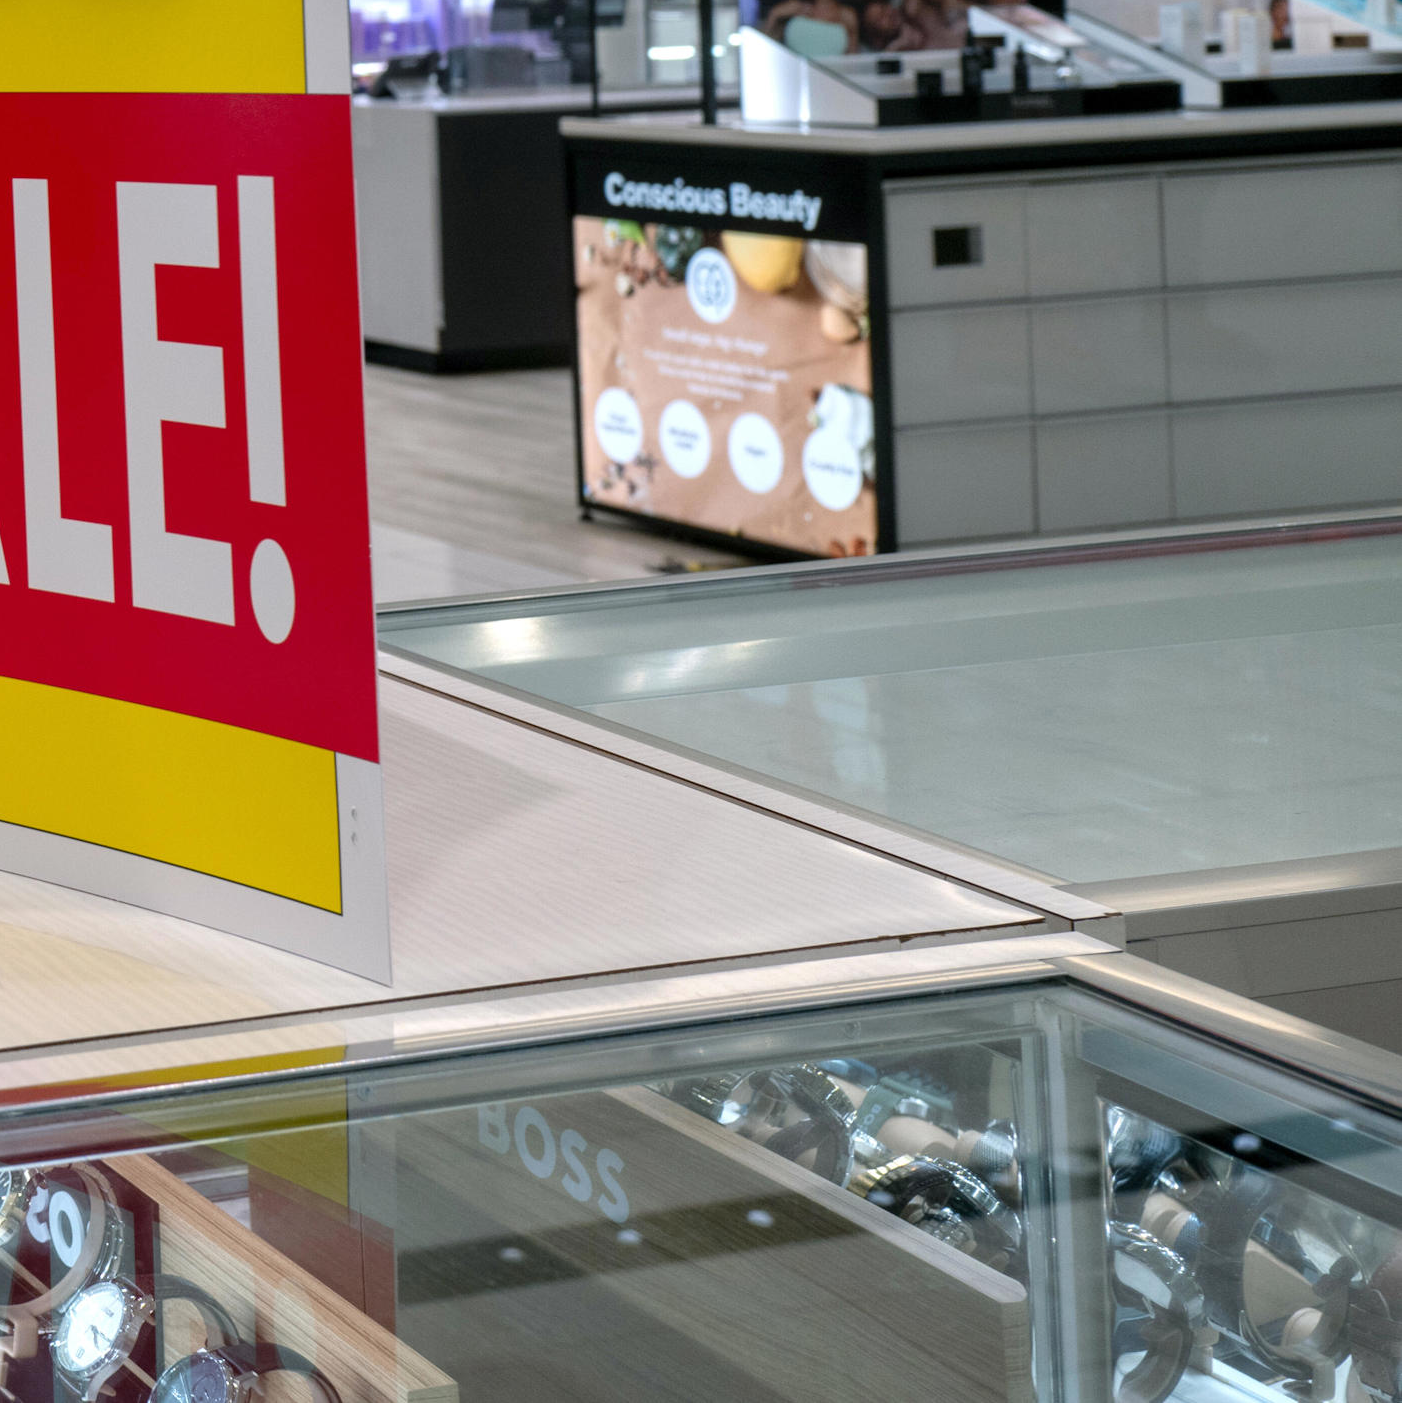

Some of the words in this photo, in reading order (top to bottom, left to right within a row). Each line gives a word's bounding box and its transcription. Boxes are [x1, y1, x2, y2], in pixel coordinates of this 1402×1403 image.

[604, 171, 726, 215] Conscious
[729, 182, 822, 230] Beauty
[477, 1105, 630, 1223] BOSS
